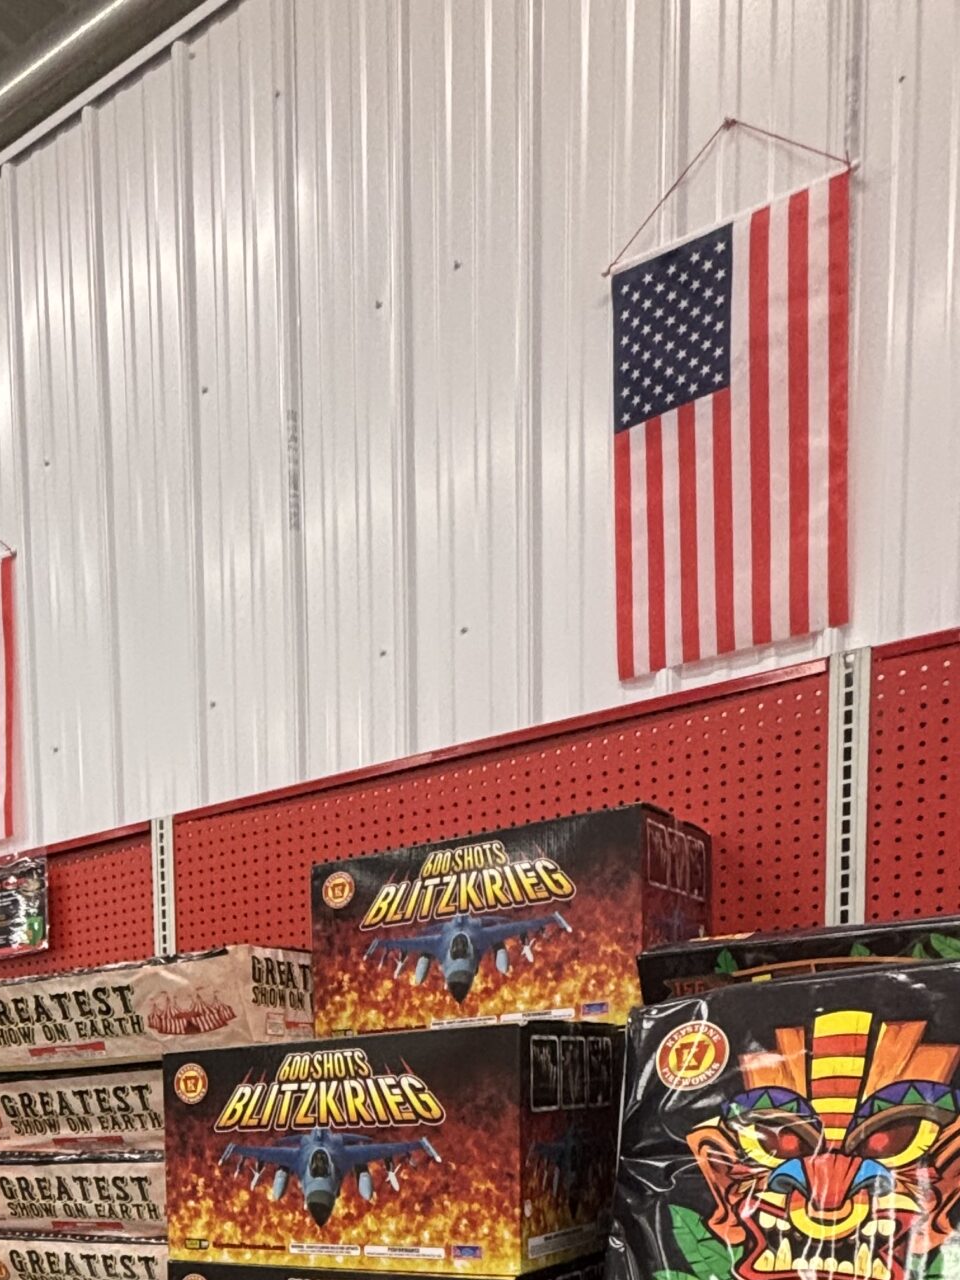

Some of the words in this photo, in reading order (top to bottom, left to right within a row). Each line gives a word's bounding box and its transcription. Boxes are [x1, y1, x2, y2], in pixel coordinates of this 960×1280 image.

[361, 859, 576, 930] BLITZKRIEG
[252, 955, 310, 992] GREAT
[45, 1022, 71, 1042] ON
[77, 1014, 146, 1040] EARTH
[0, 1084, 153, 1120] GREATEST
[215, 1075, 445, 1132] BLITZKRIEG
[11, 1115, 60, 1137] SHOW
[68, 1113, 92, 1133] ON
[101, 1111, 163, 1131] EARTH
[7, 1202, 58, 1219] SHOW
[64, 1202, 90, 1219] ON
[96, 1202, 163, 1221] EARTH
[9, 1249, 159, 1280] GREATEST
